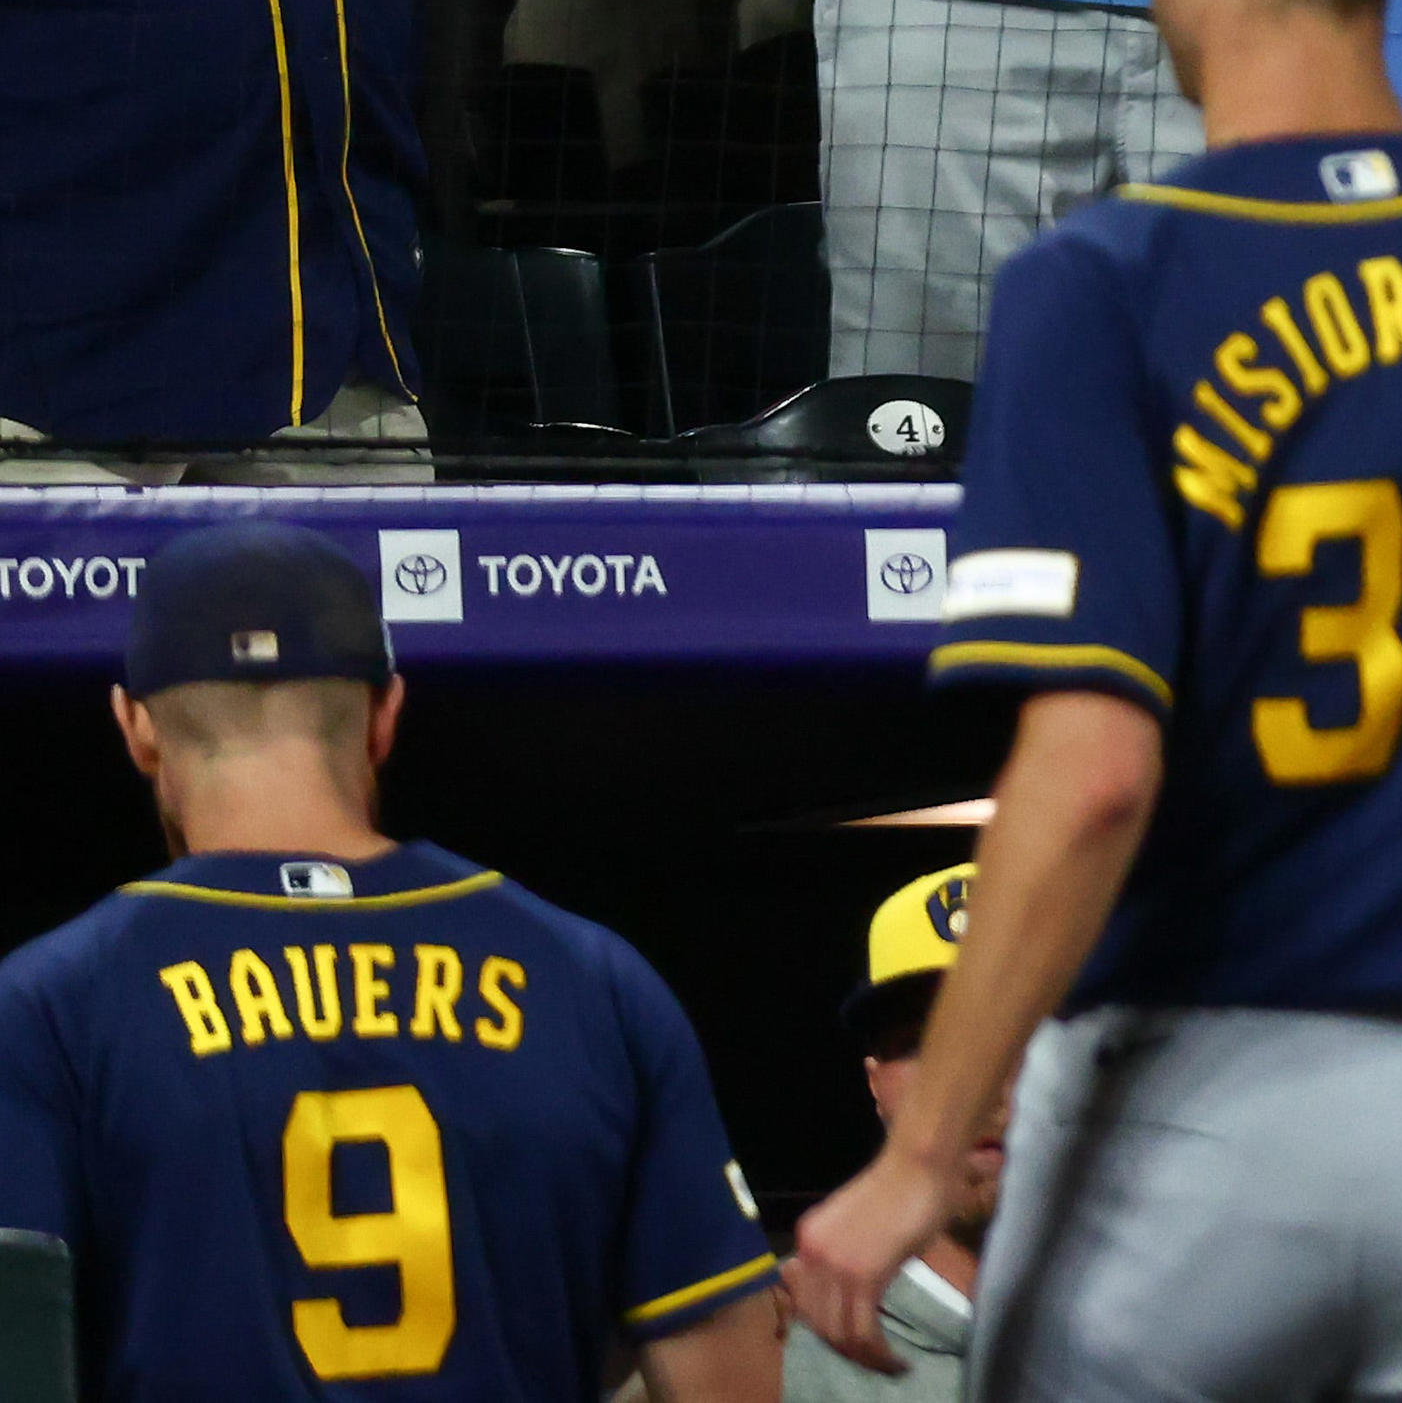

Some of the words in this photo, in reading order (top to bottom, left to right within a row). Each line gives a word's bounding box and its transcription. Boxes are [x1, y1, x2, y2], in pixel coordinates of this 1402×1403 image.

[896, 414, 921, 443] 4
[0, 556, 147, 598] TOYOT
[478, 554, 669, 597] TOYOTA
[159, 942, 527, 1057] BAUERS
[283, 1084, 457, 1381] 9
